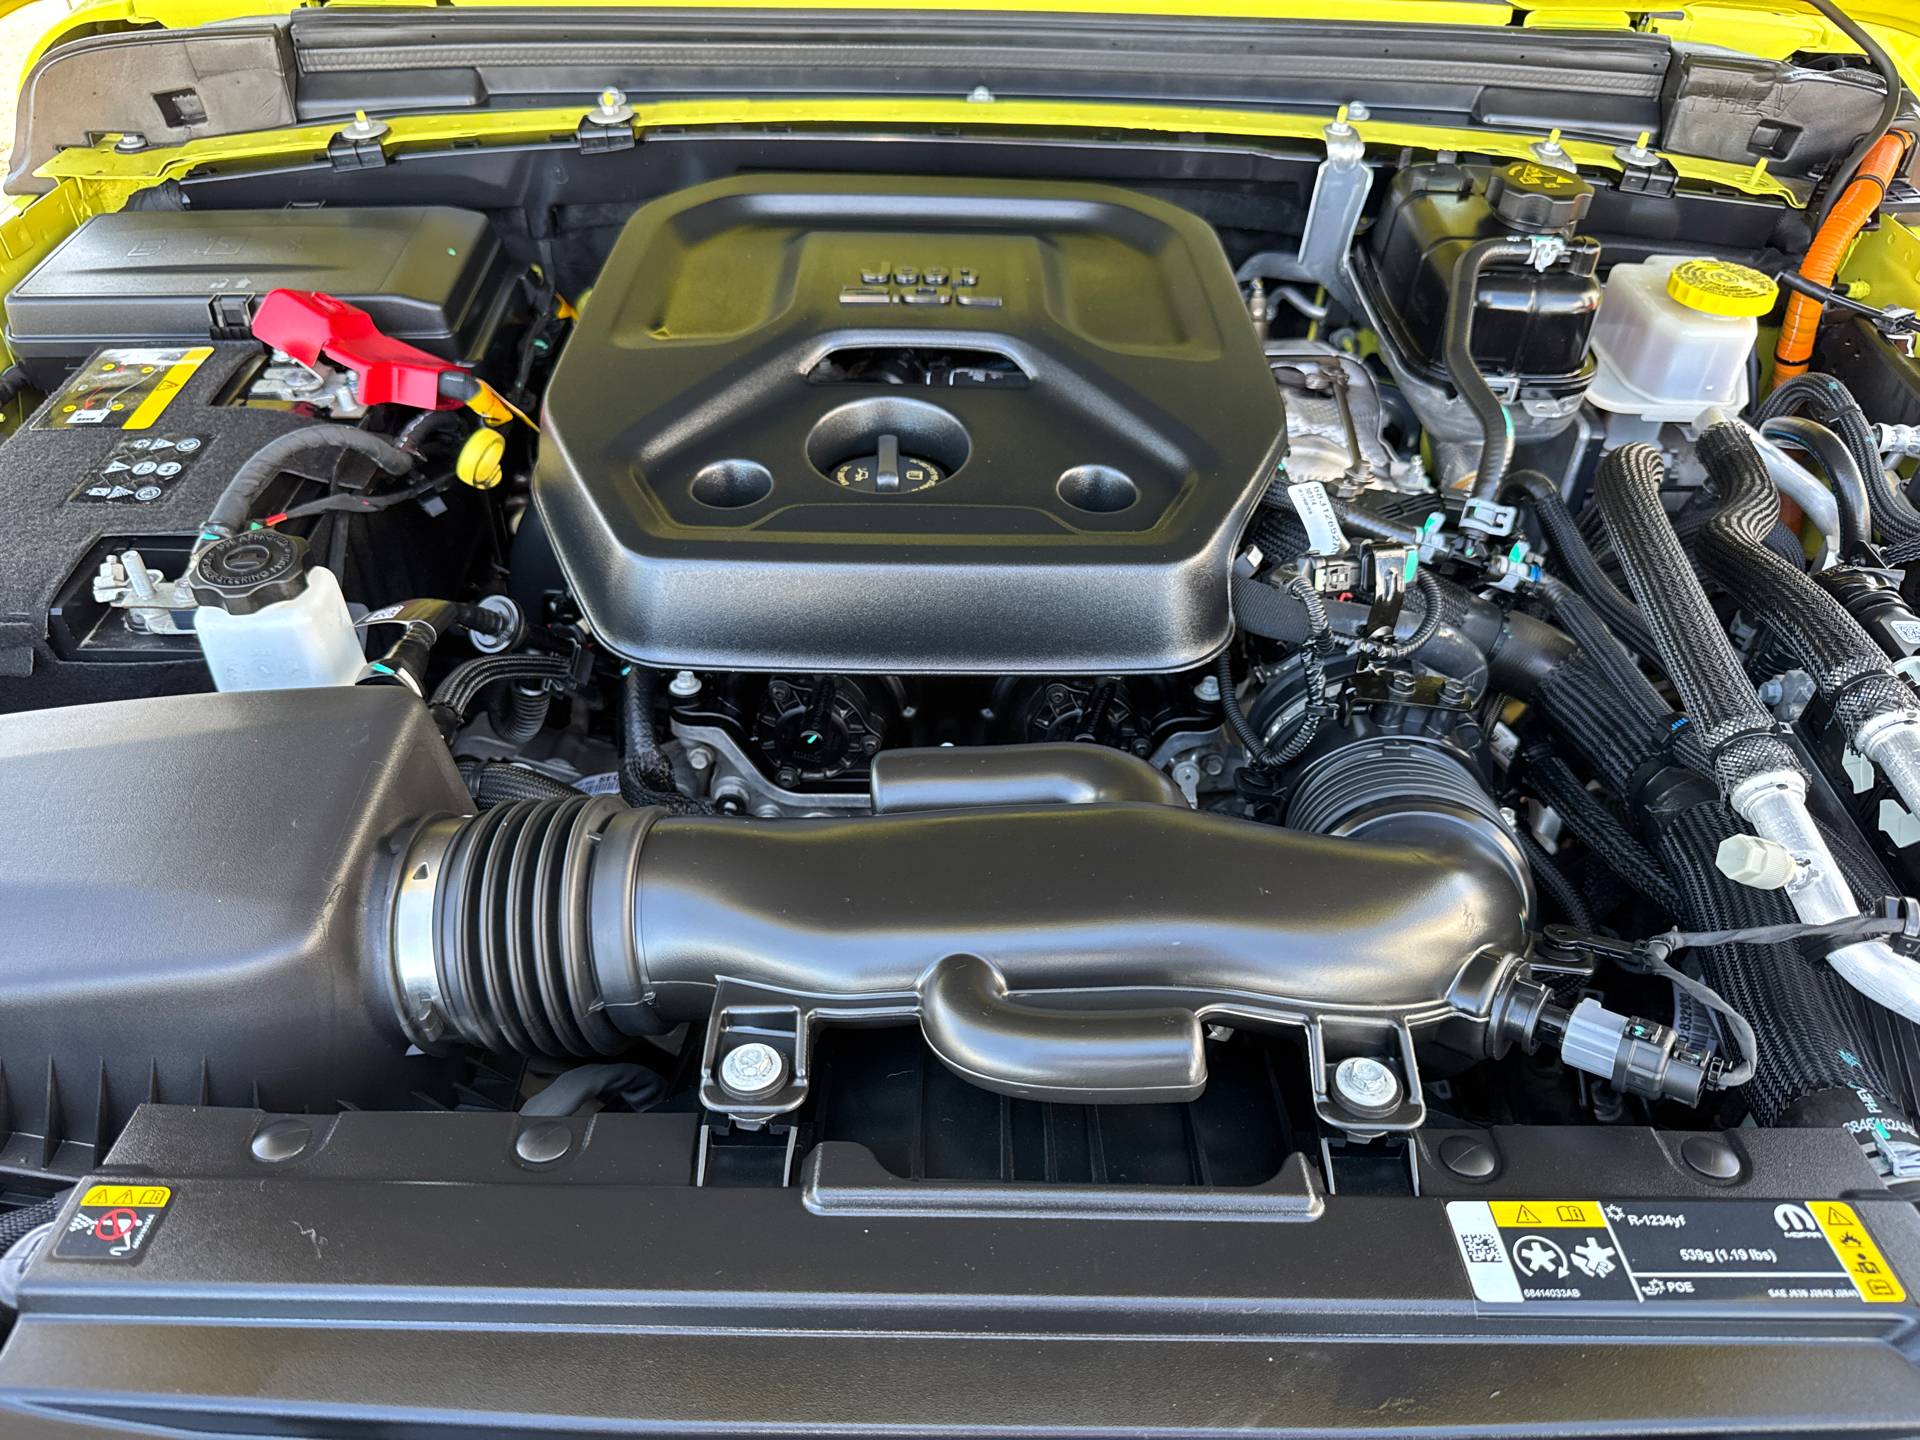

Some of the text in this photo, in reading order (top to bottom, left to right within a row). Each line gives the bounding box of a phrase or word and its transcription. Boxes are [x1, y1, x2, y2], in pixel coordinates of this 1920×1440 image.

[1313, 486, 1341, 554] 68312652A
[239, 532, 289, 547] APPROVED
[217, 570, 270, 585] STEERING
[1627, 1214, 1686, 1229] R-1234yf
[1783, 1231, 1823, 1239] MOPAR
[1679, 1248, 1778, 1263] 539g (1.19 lbs)
[1523, 1288, 1581, 1298] 68414033AB
[1666, 1281, 1695, 1293] POE
